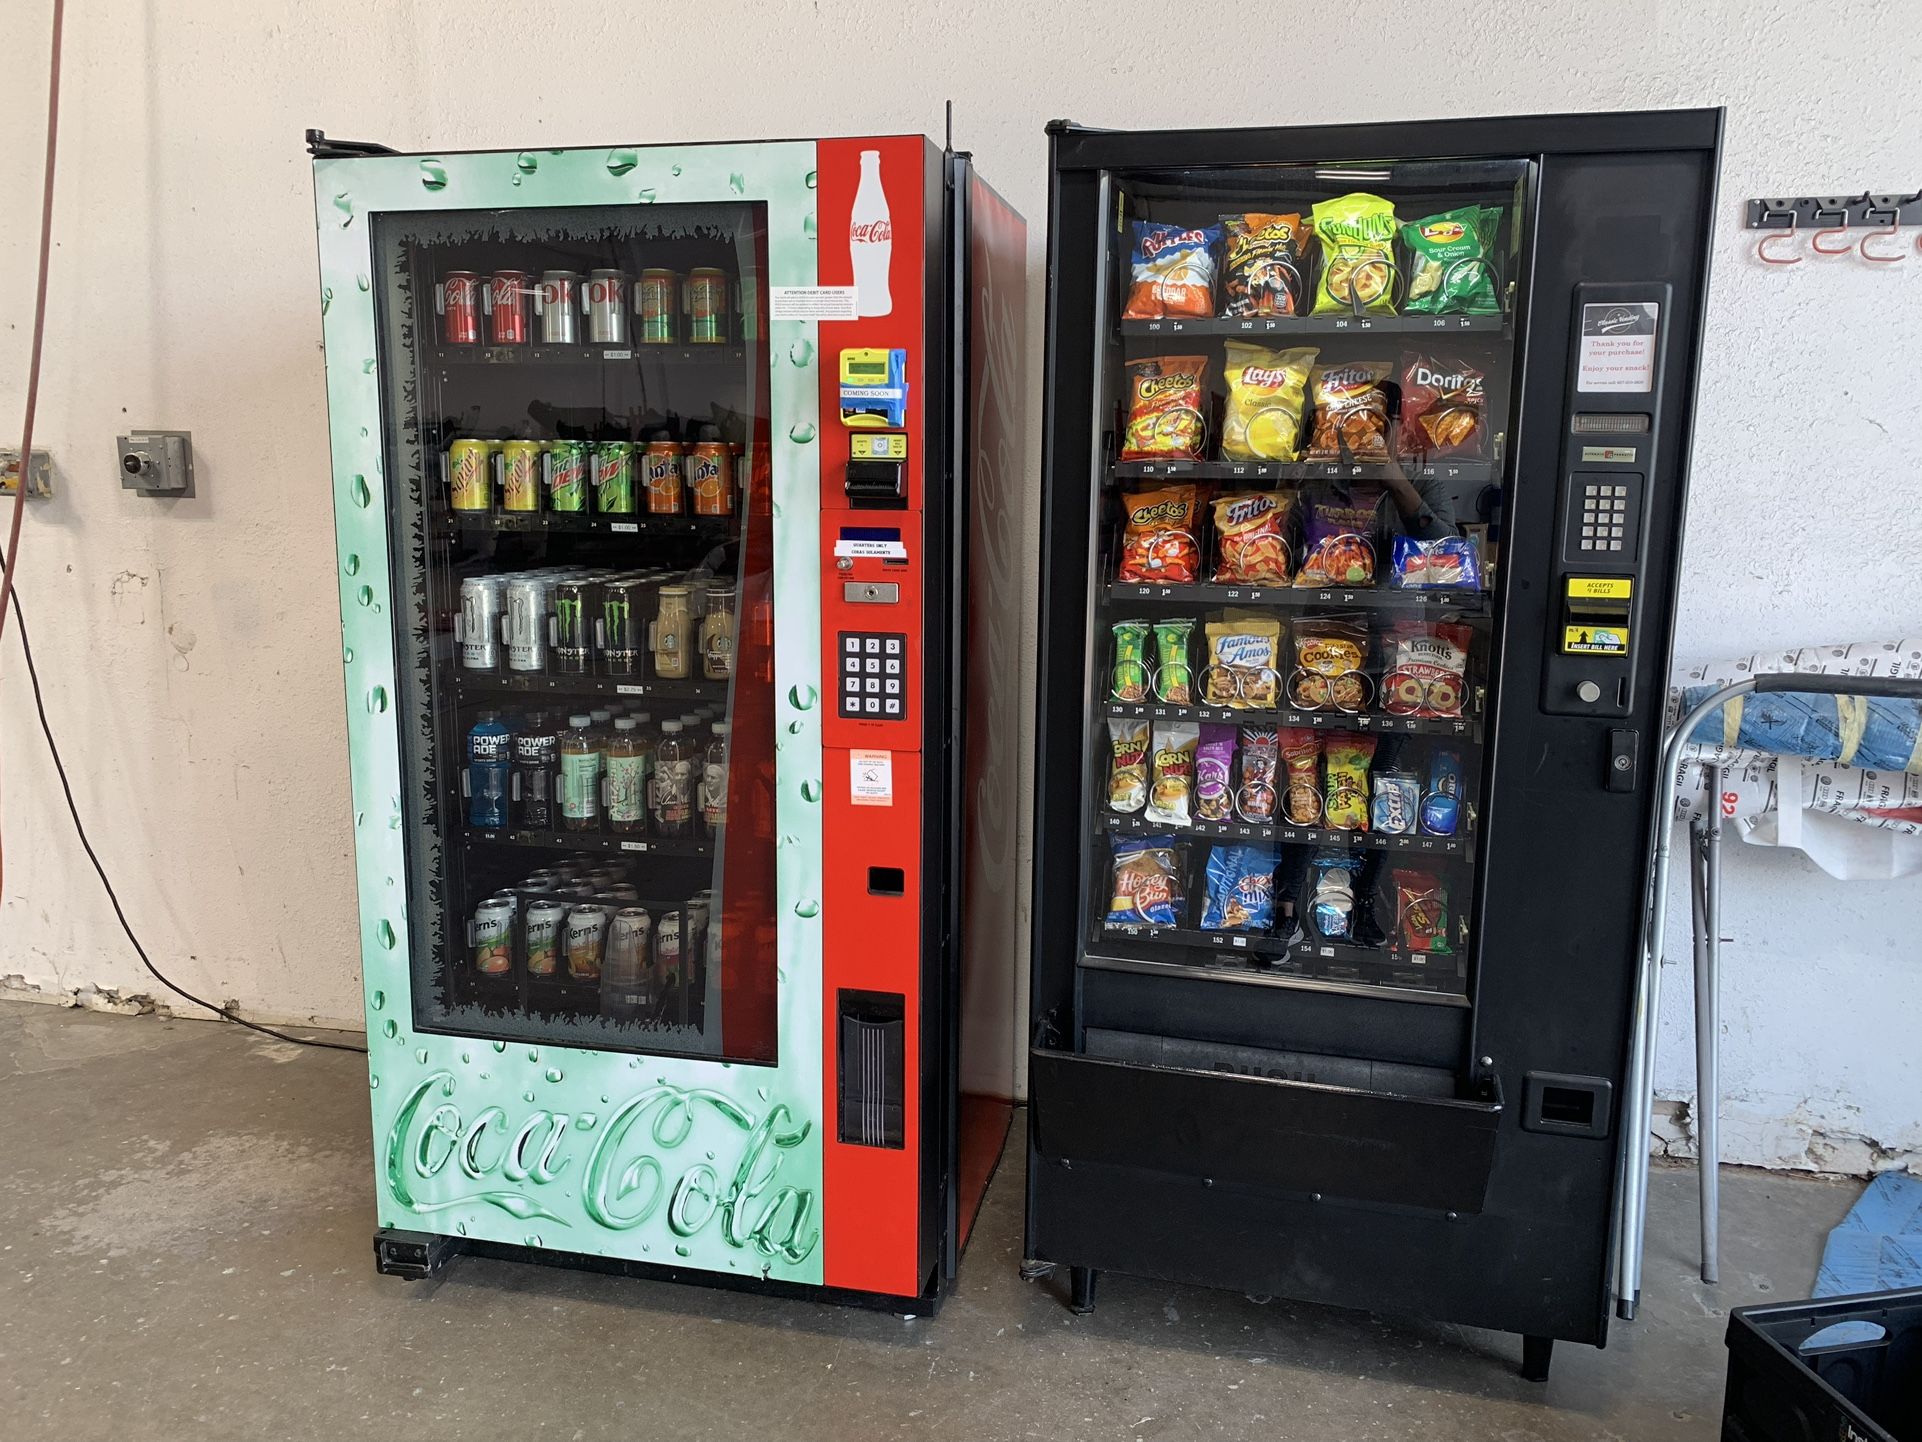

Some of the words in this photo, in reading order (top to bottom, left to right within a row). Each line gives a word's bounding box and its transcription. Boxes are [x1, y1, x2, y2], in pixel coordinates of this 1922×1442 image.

[1429, 246, 1446, 254] Sour
[1447, 245, 1471, 253] Cream
[1433, 319, 1445, 327] 106
[1608, 349, 1645, 357] purchase!
[1582, 365, 1604, 373] Enjoy
[1416, 367, 1484, 390] Doritos
[1140, 375, 1194, 399] Cheetos
[1132, 501, 1188, 525] Cheetos
[1226, 497, 1276, 526] Fritos
[1216, 635, 1270, 655] Famous
[1411, 640, 1452, 660] Knott's
[1571, 642, 1591, 650] INSERT
[1226, 647, 1271, 663] Amos
[1303, 649, 1360, 664] Cookies
[473, 734, 510, 746] POWER
[518, 736, 556, 747] POWER
[1112, 740, 1142, 754] CORN
[473, 745, 497, 755] ADE
[519, 746, 540, 756] ADE
[1155, 749, 1190, 768] CORN
[1386, 783, 1405, 830] EXTRA
[1121, 869, 1169, 893] Honey
[1138, 886, 1167, 908] Bun
[384, 1069, 820, 1266] Coca-Cola
